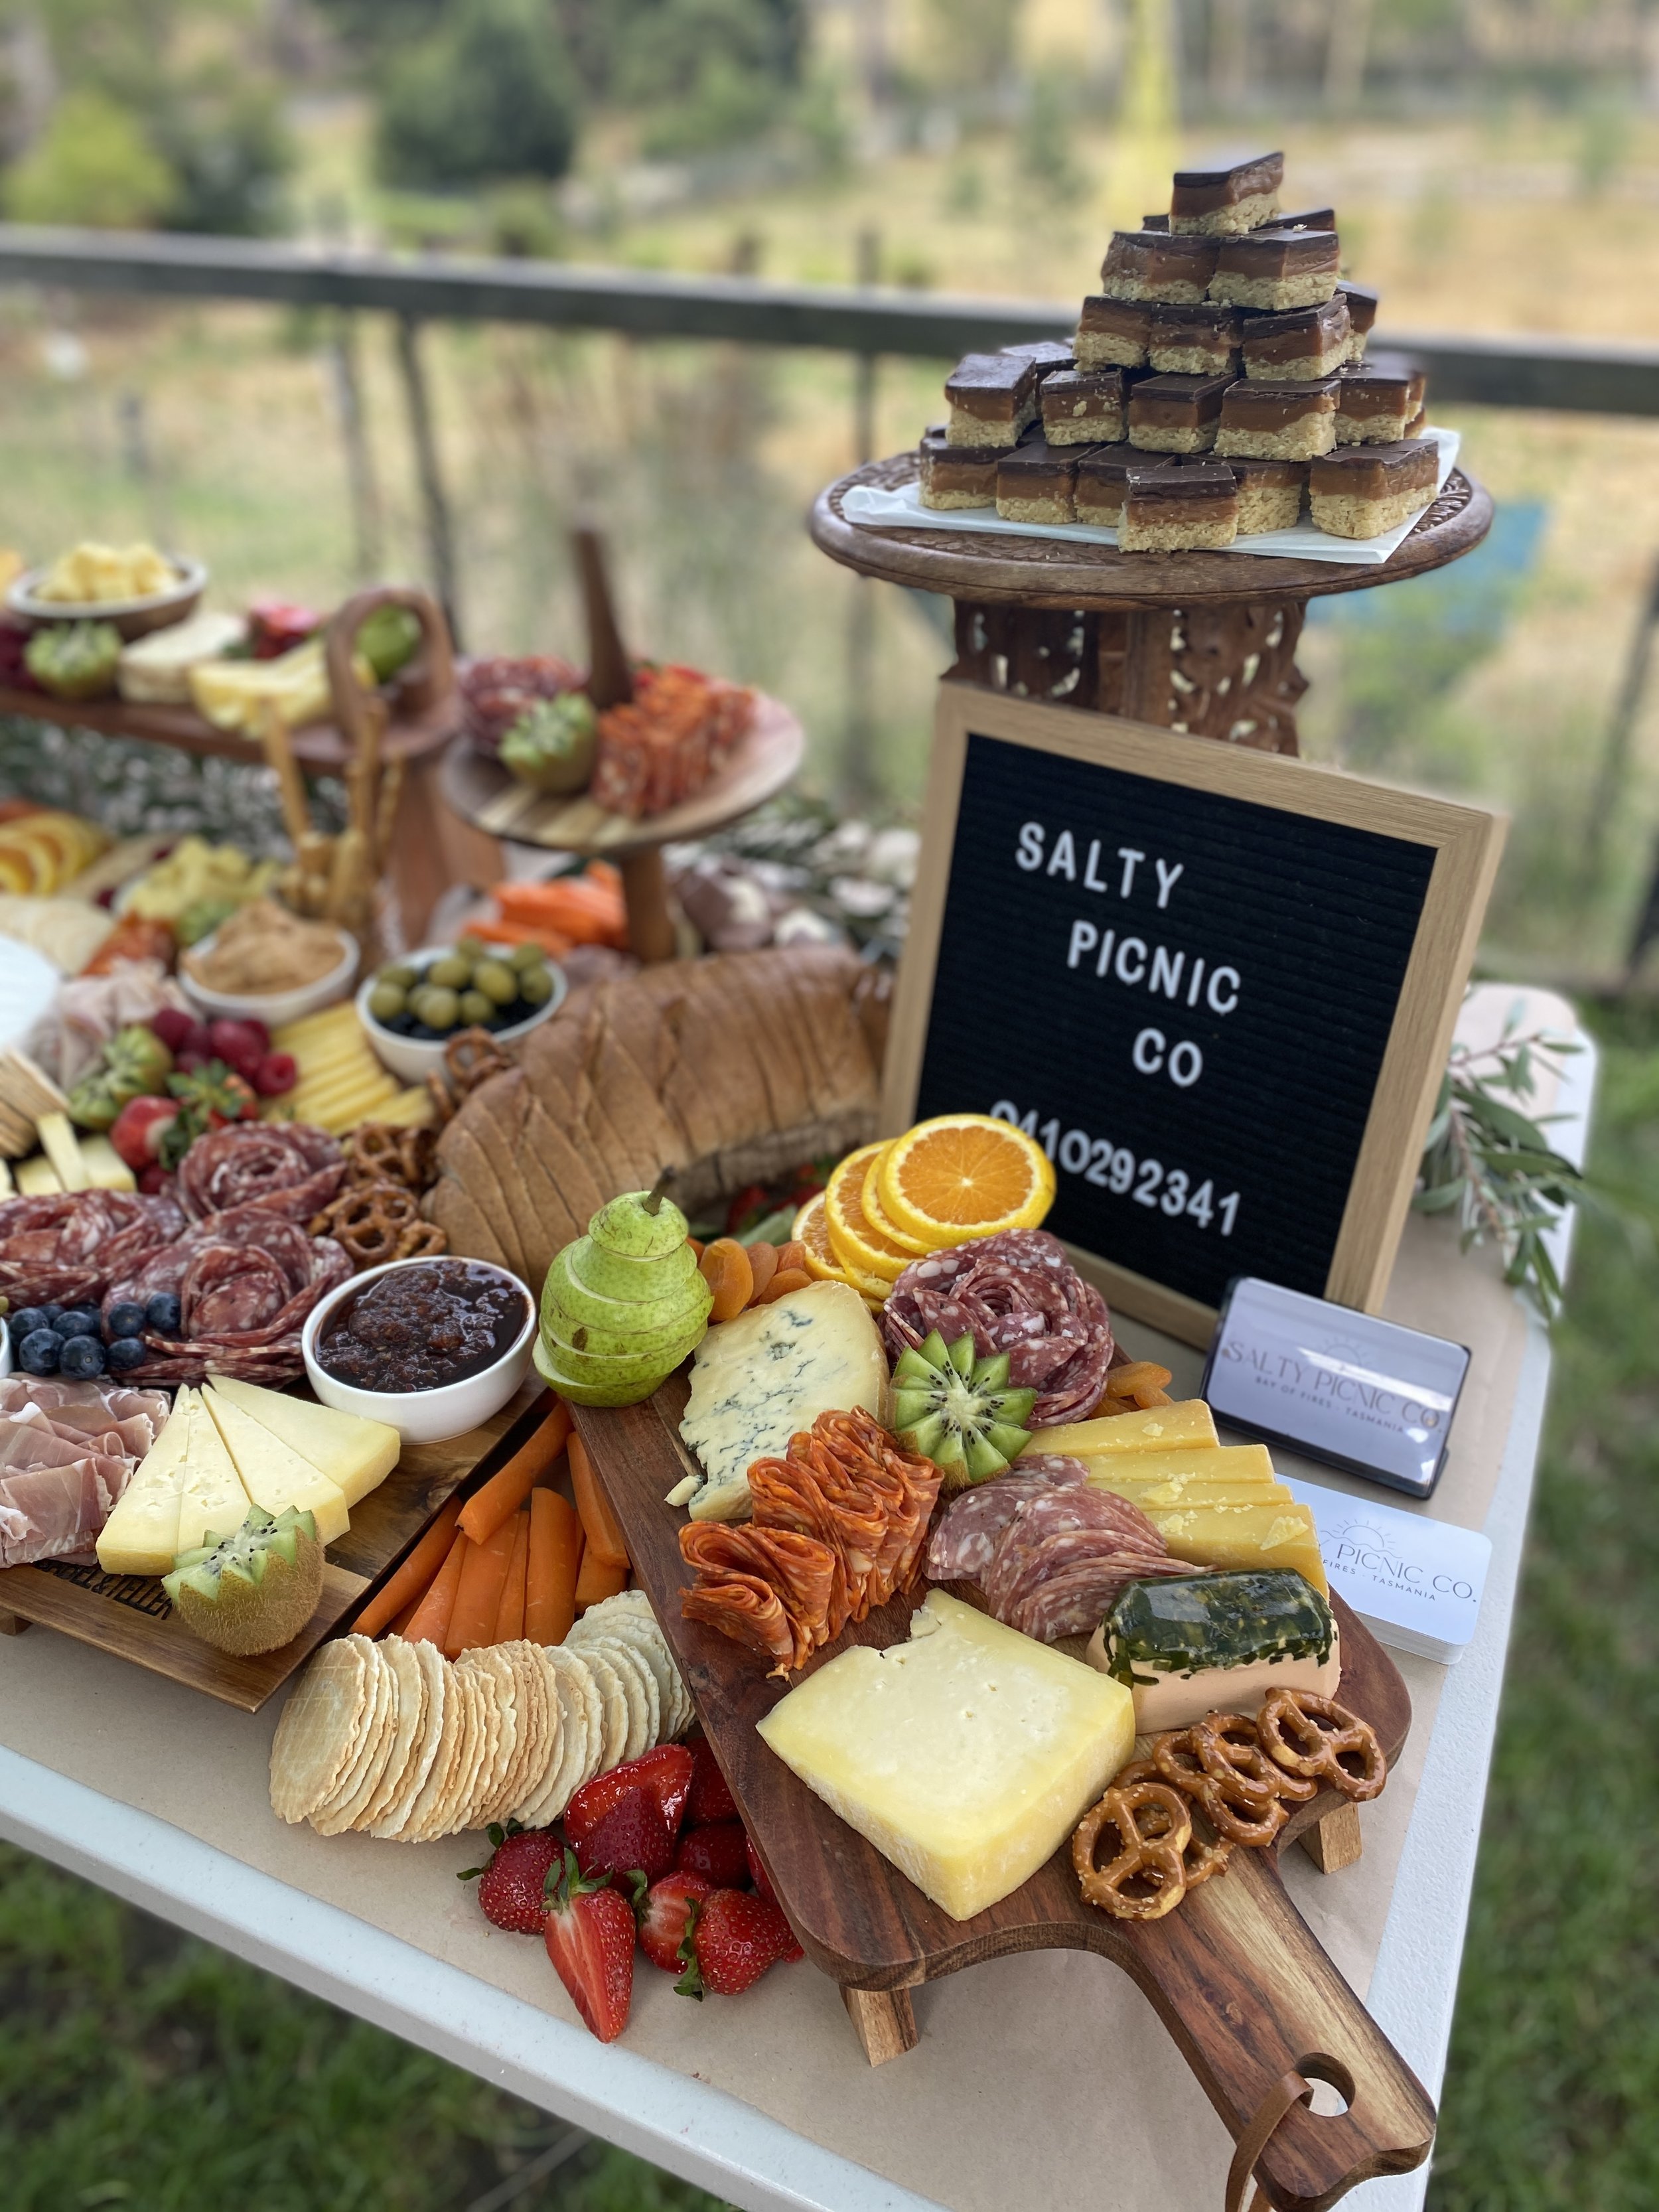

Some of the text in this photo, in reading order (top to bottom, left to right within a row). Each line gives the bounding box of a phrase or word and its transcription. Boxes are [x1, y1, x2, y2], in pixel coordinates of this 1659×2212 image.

[1015, 822, 1184, 909] SALTY
[1067, 920, 1241, 1014] PICNIC
[1133, 1027, 1203, 1087] CO
[1228, 1341, 1443, 1434] SALTY PICNIC CO.
[1255, 1375, 1405, 1434] BAY OF FIRES TASMANIA
[1323, 1559, 1436, 1601] FIRES TASMANIA
[1336, 1543, 1477, 1603] PICNIC CO.
